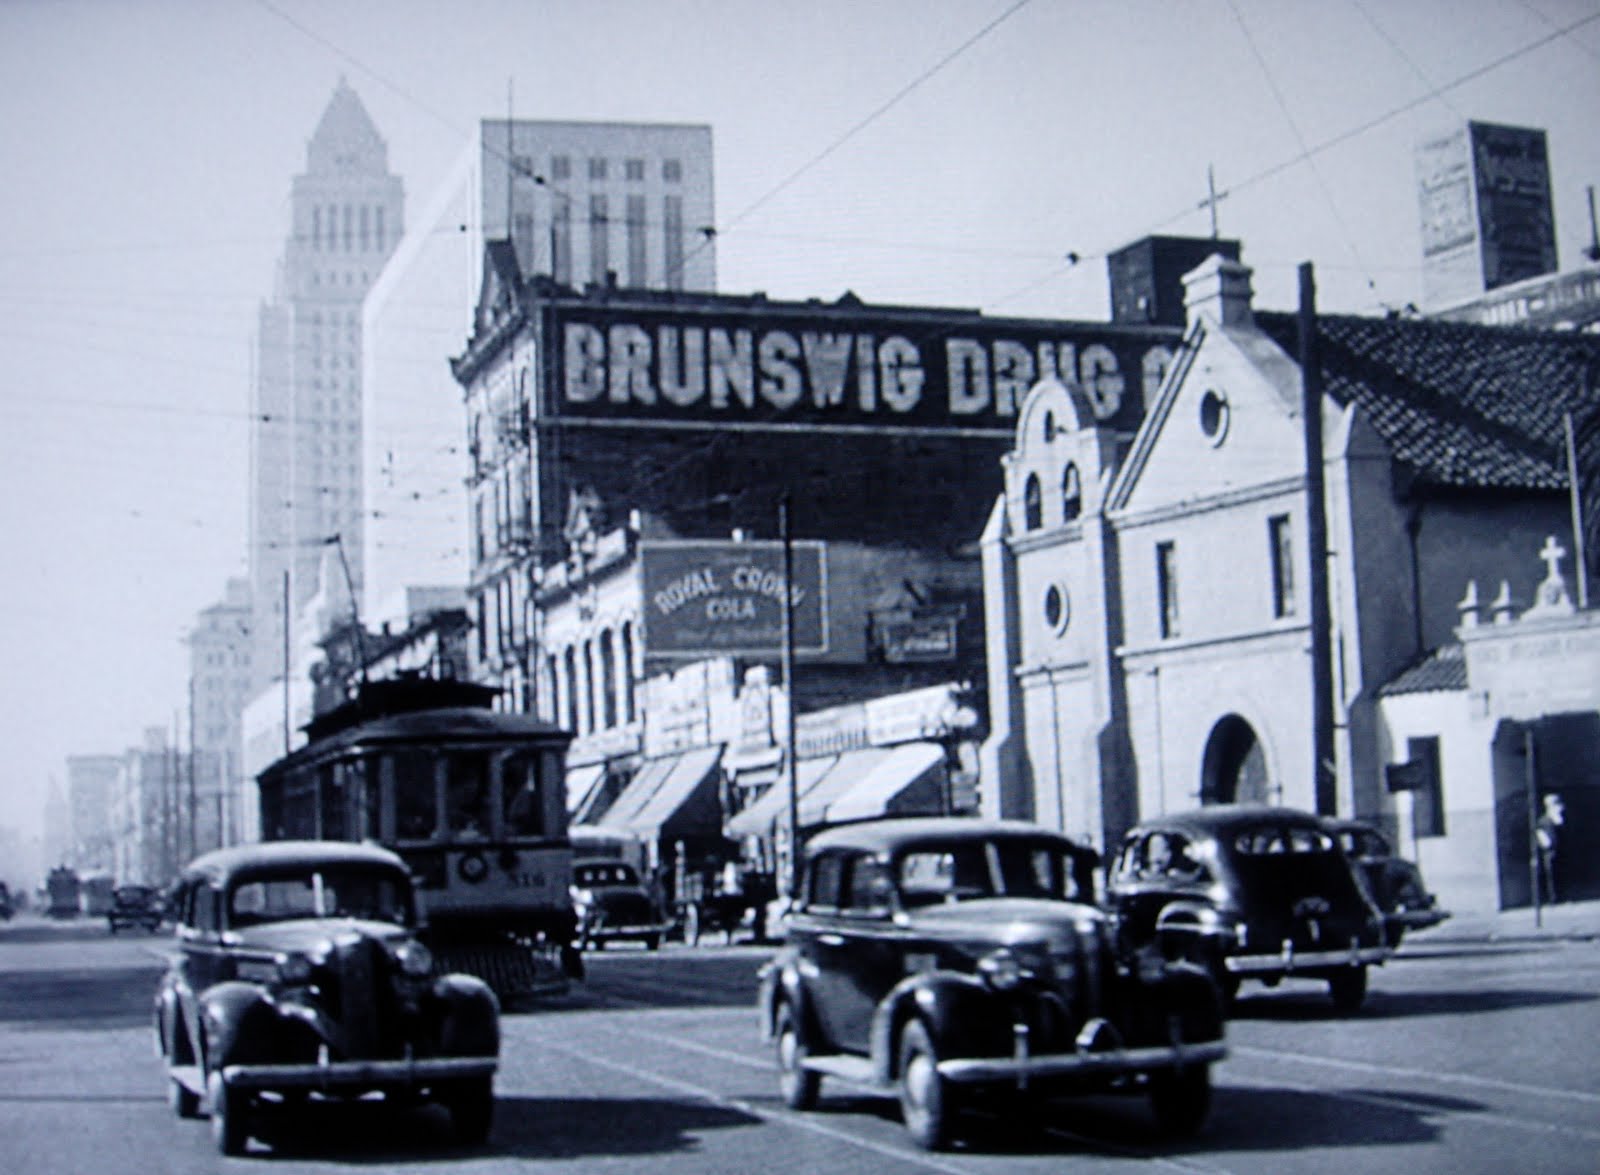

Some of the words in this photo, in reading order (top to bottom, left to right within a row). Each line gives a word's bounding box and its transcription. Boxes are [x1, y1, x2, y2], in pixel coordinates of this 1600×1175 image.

[563, 322, 925, 413] BRUNSWIG
[654, 568, 722, 615] ROYAL
[705, 597, 756, 621] COLA
